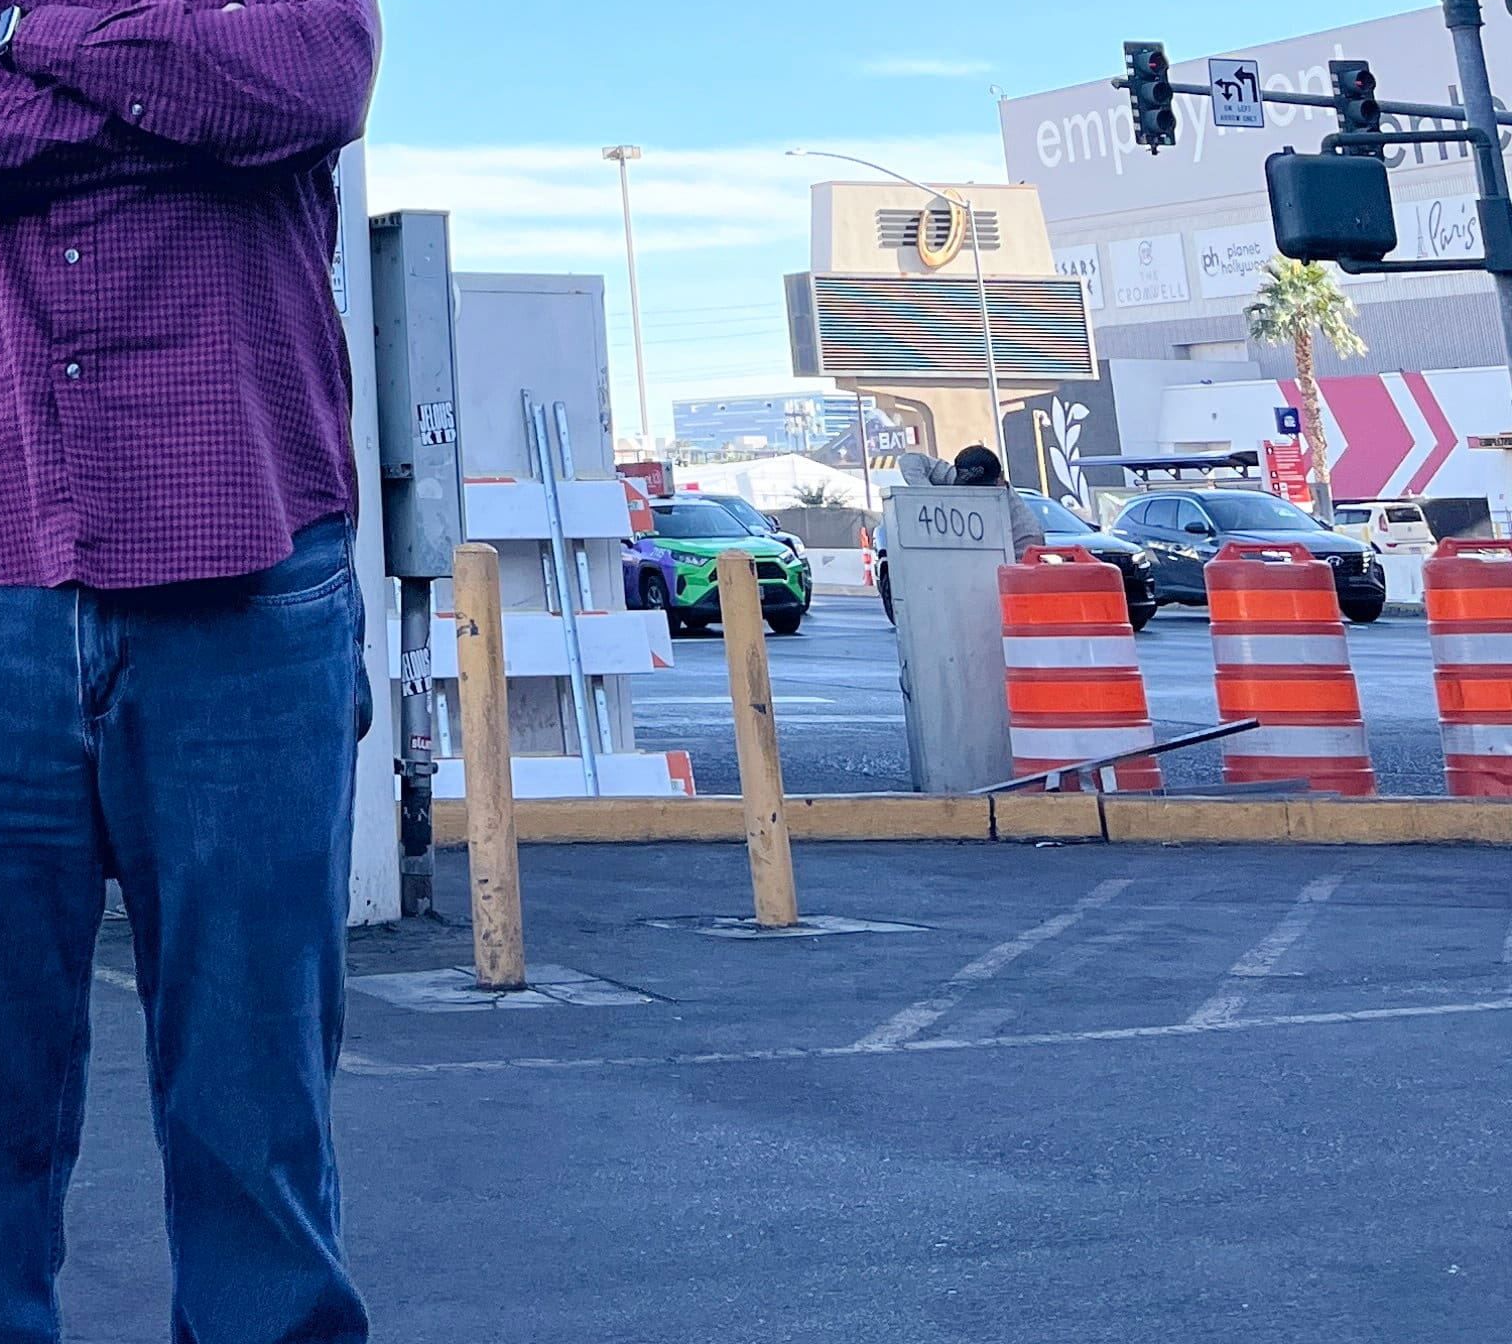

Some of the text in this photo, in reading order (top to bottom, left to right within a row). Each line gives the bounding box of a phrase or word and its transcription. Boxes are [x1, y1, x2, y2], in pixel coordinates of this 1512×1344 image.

[1428, 200, 1477, 258] Paris
[1226, 242, 1262, 260] planet
[1220, 256, 1272, 277] hollywo
[1117, 287, 1185, 304] CROMWELL
[918, 505, 984, 541] 4000
